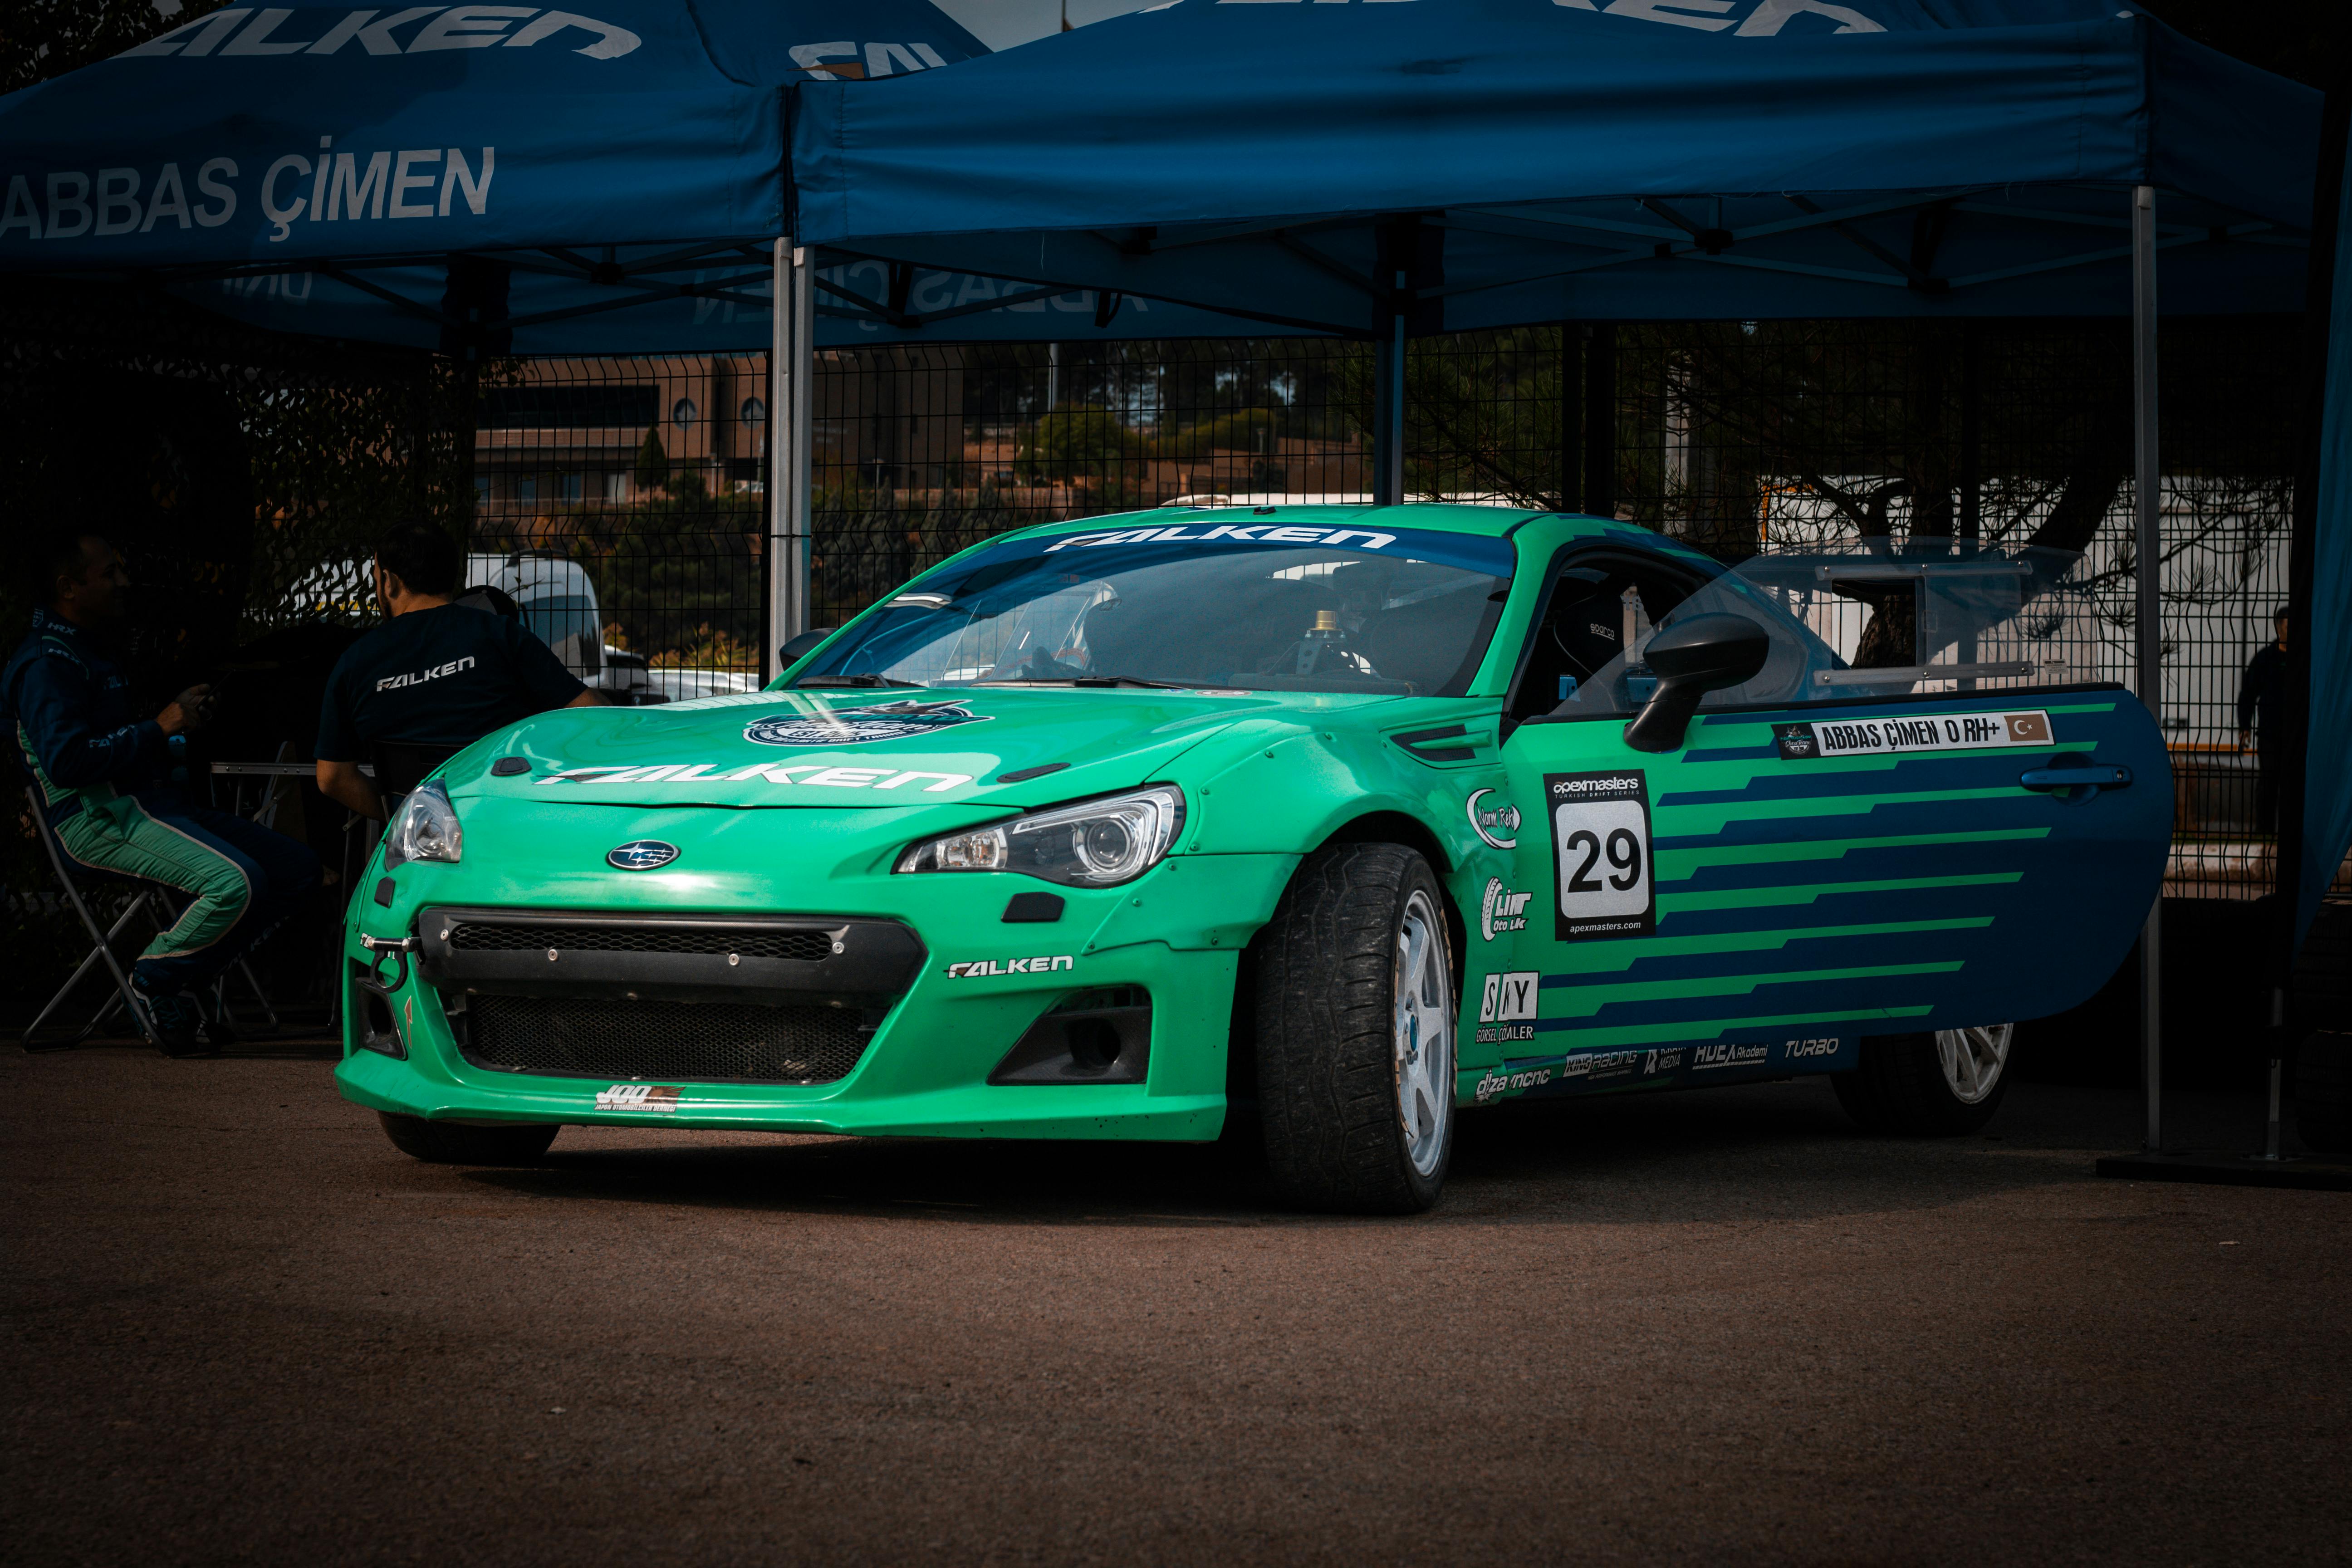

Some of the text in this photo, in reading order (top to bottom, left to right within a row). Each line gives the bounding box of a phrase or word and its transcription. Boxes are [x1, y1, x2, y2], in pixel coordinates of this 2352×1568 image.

[105, 6, 642, 59] ALKEN
[0, 135, 495, 242] ABBAS ÇİMEN
[1044, 526, 1397, 553] FALKEN
[47, 622, 77, 636] HRX
[1590, 623, 1615, 638] sparco
[376, 656, 475, 692] FALKEN
[1822, 724, 1882, 751] ABBAS
[1883, 719, 1939, 750] ÇİMEN
[1964, 718, 2000, 742] RH+
[533, 763, 975, 792] FALKEN
[1553, 777, 1638, 794] apexmasters
[1477, 805, 1514, 829] Norm Rek
[1566, 828, 1642, 893] 29
[1570, 920, 1641, 934] apexmasters.com
[948, 955, 1073, 979] FALKEN
[1476, 1025, 1497, 1043] GÖRSEL
[1785, 1038, 1839, 1058] TURBO
[1657, 1054, 1681, 1071] MEDIA
